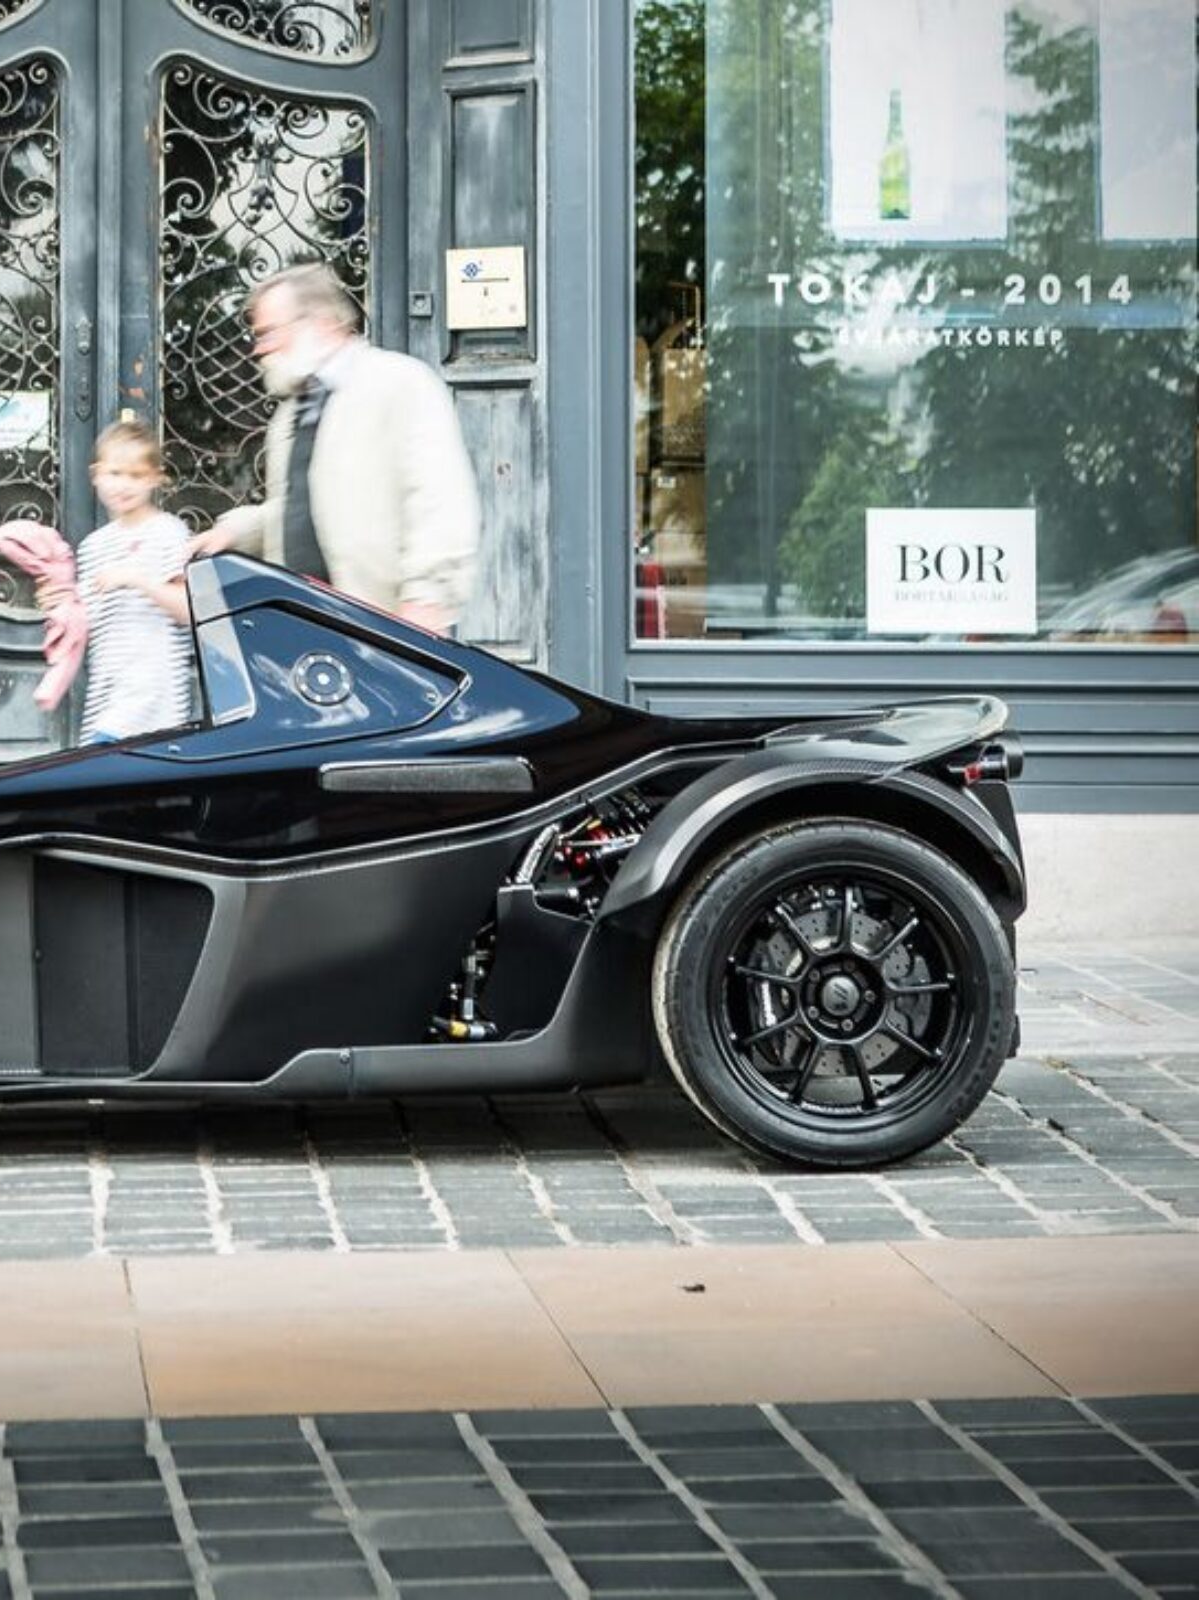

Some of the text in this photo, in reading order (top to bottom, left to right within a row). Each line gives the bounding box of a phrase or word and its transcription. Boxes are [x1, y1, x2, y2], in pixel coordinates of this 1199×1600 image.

[768, 273, 936, 306] TOKAJ
[1003, 274, 1132, 304] 2014
[896, 543, 1010, 584] BOR
